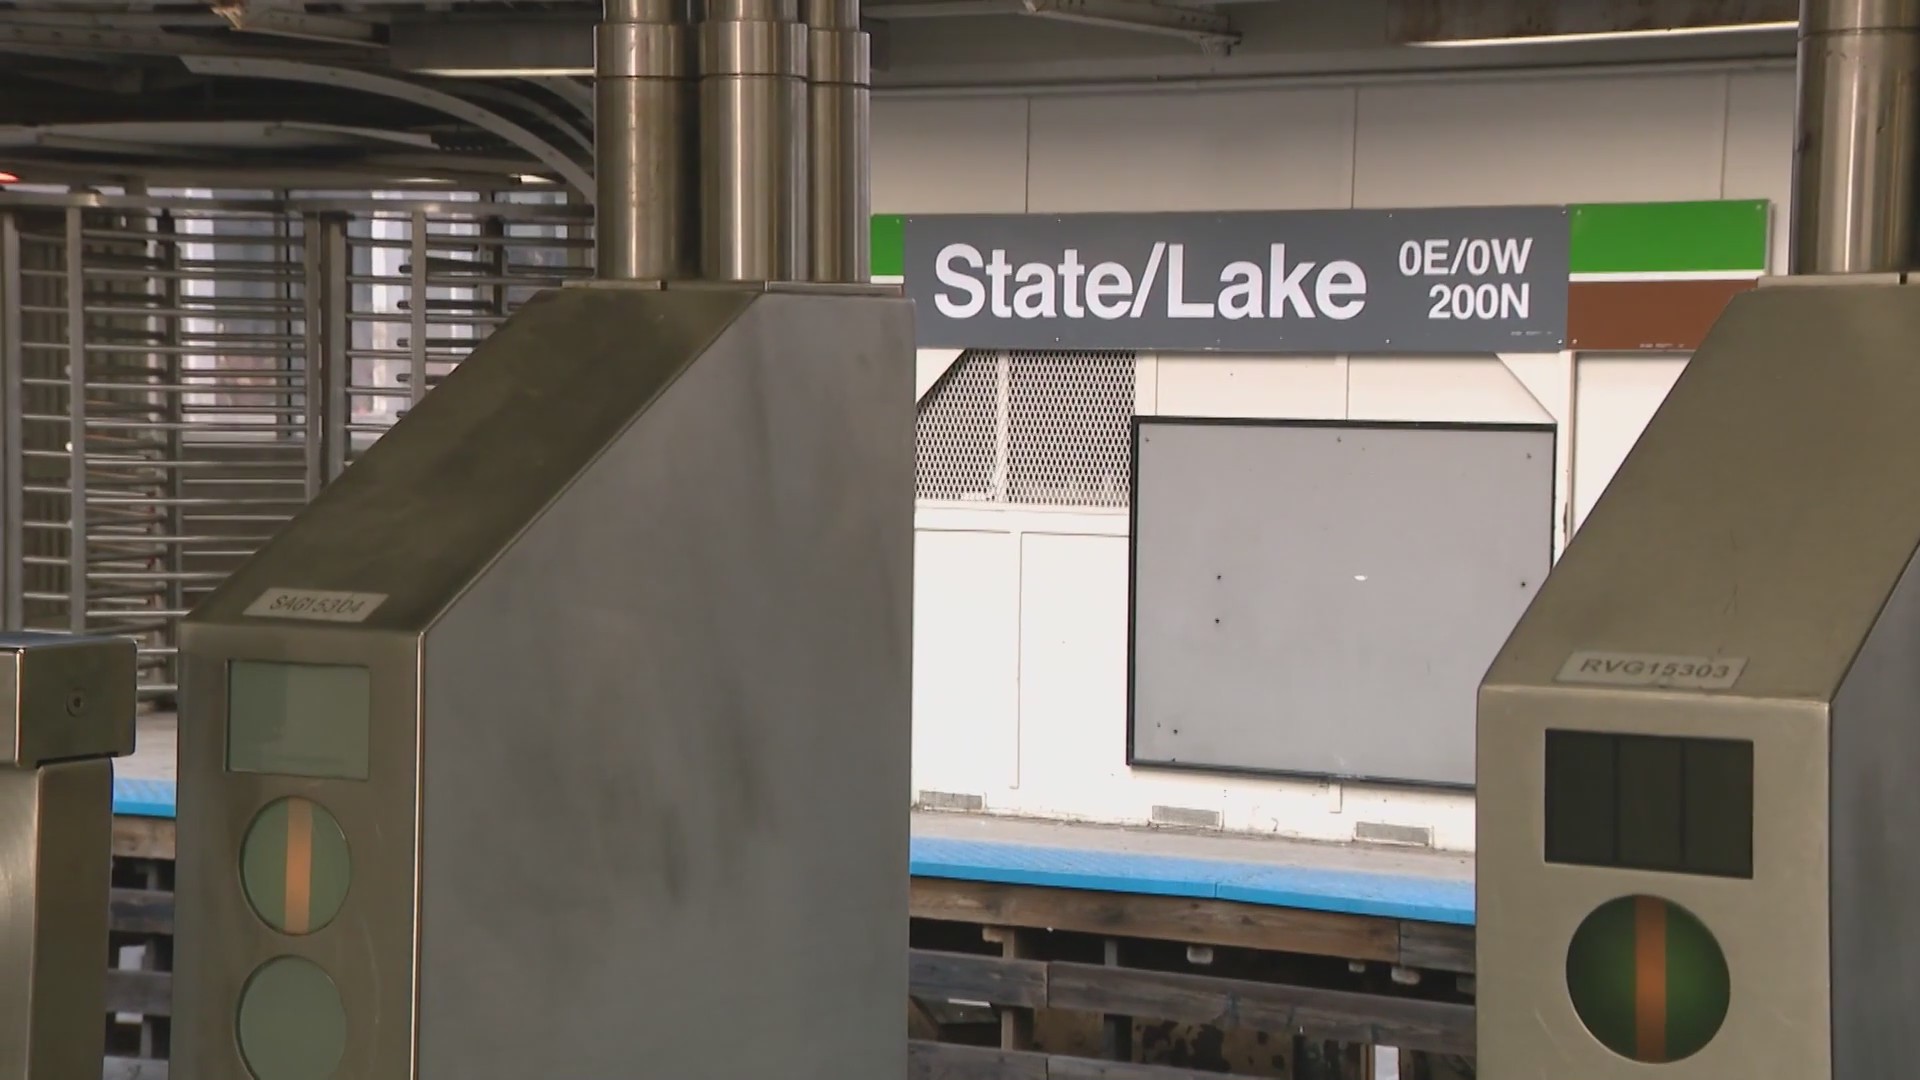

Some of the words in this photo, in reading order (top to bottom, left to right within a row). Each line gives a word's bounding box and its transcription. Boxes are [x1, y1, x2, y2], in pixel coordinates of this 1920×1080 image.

[1398, 237, 1533, 276] 0E/0W
[934, 241, 1367, 320] State/Lake
[1428, 282, 1530, 320] 200N
[1579, 658, 1731, 679] RVG15303
